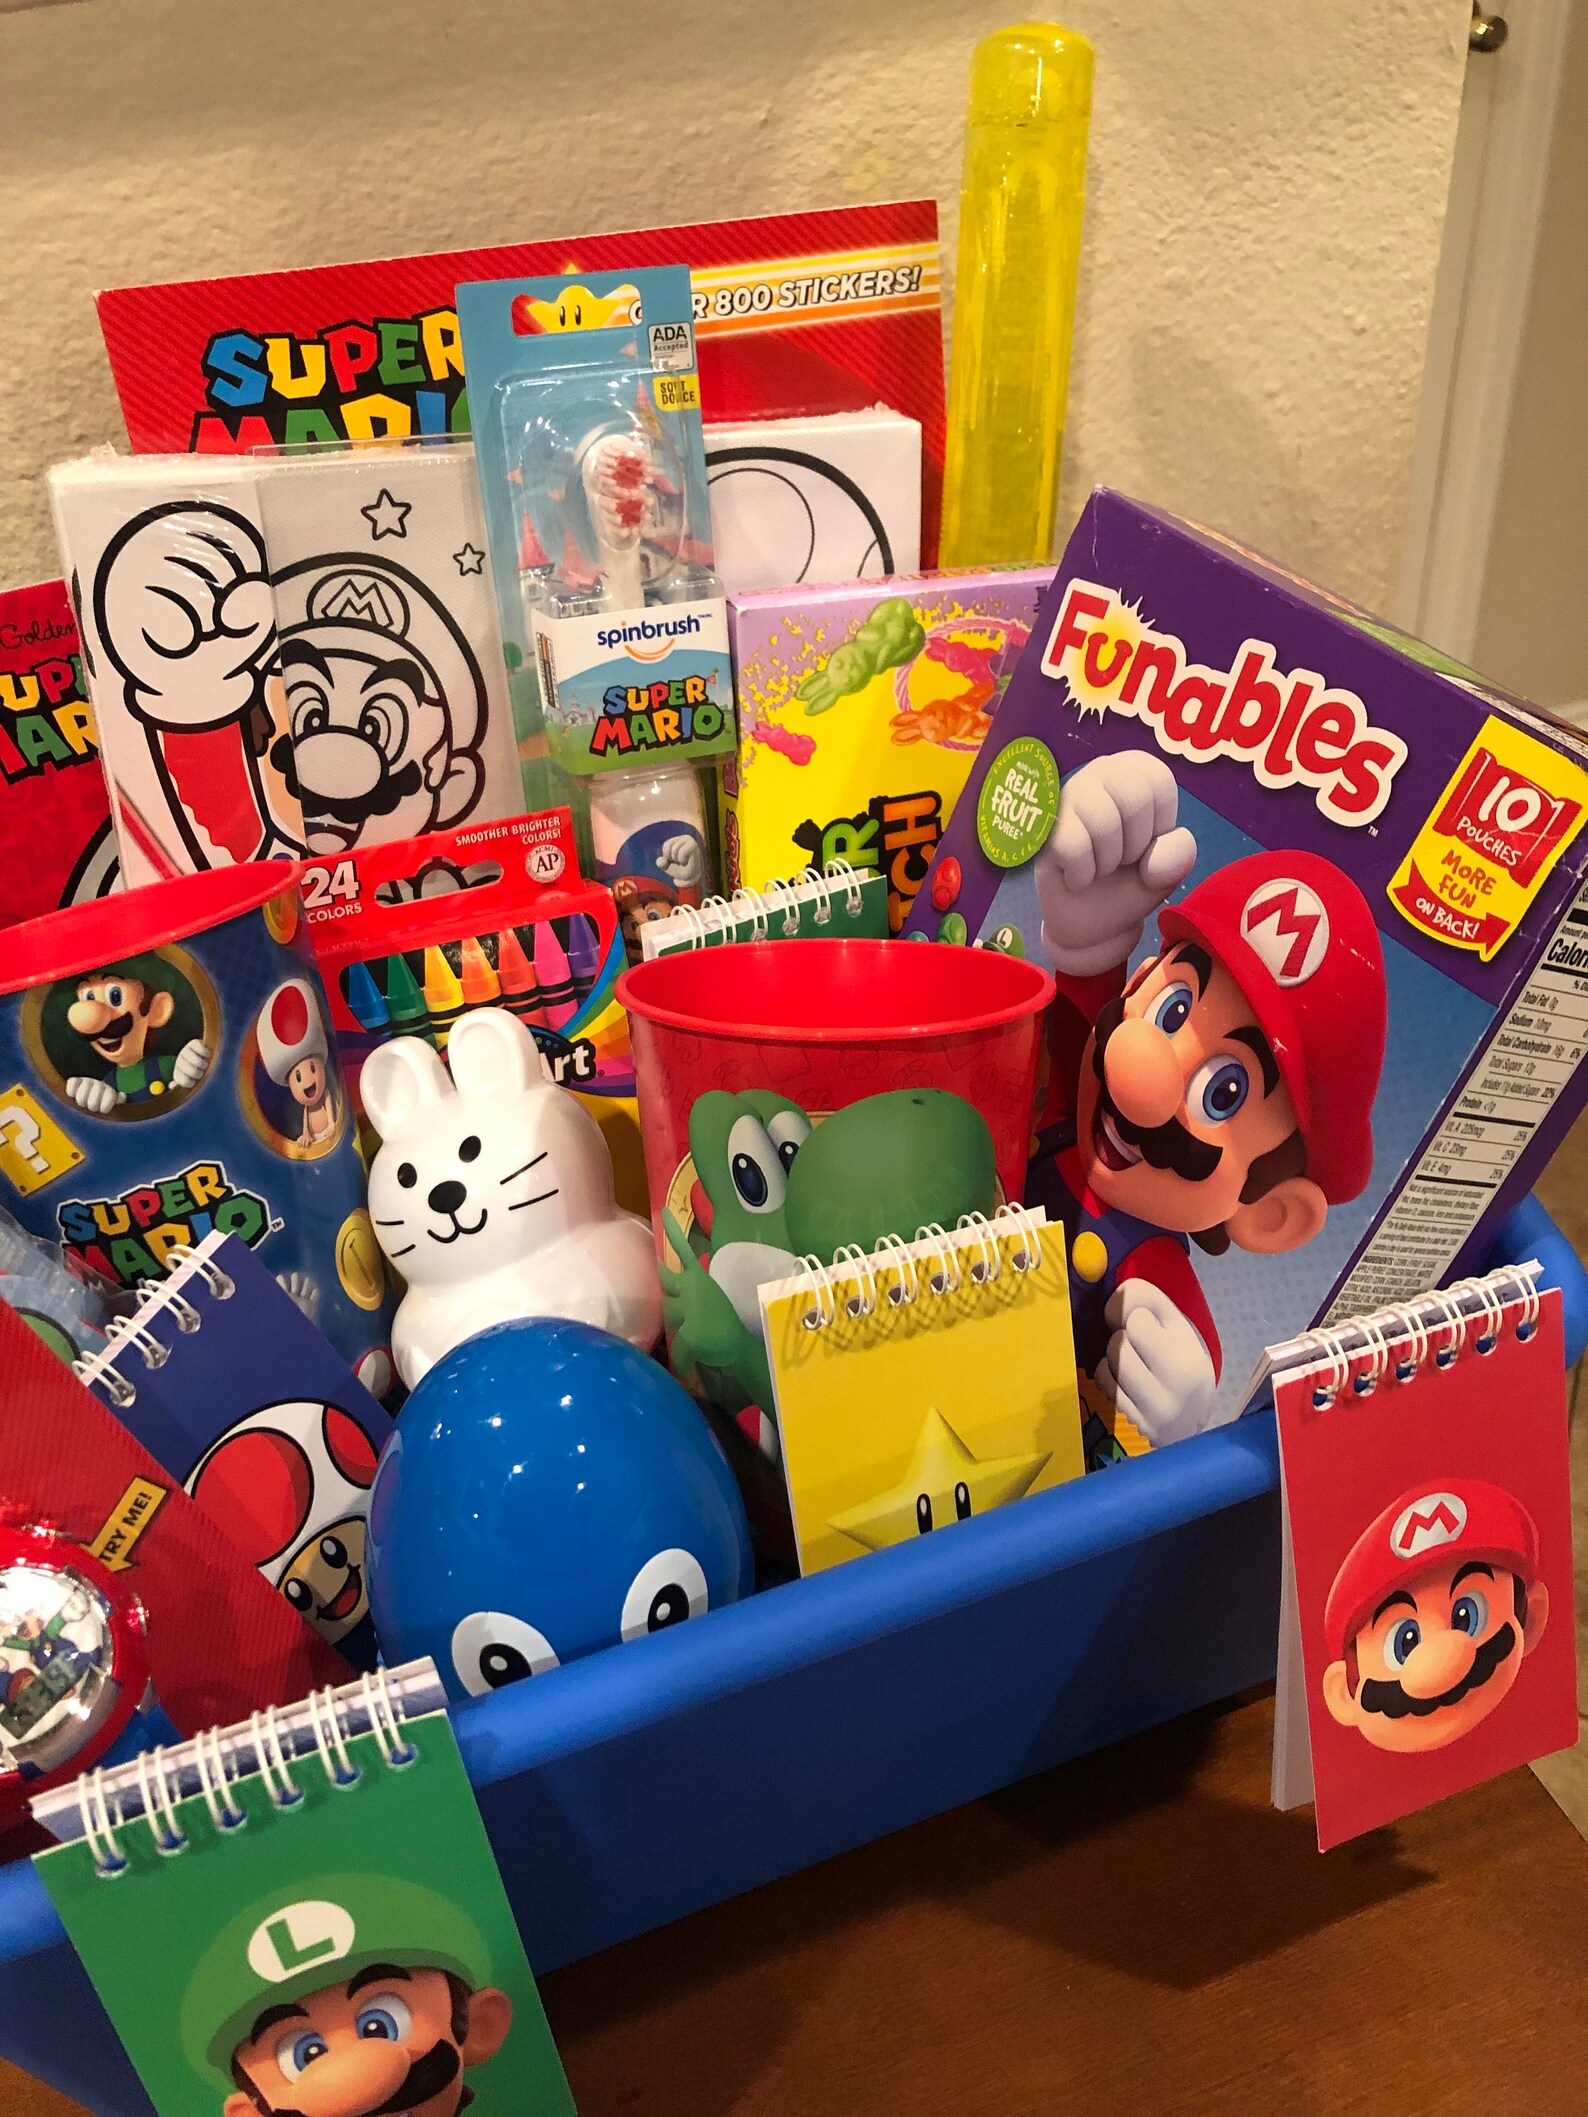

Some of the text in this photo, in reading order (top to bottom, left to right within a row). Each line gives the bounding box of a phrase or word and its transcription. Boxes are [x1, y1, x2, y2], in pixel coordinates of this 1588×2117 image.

[714, 284, 772, 316] 800
[778, 265, 921, 308] STICKERS!
[653, 326, 687, 342] ADA
[653, 341, 689, 353] Accepted
[204, 308, 466, 408] SUPER
[662, 391, 695, 405] DOCE
[193, 392, 468, 456] MARI
[597, 614, 700, 649] spinbrush
[603, 675, 708, 716] SUPER
[1046, 586, 1398, 815] Funables
[589, 703, 724, 757] MARIO
[1005, 768, 1039, 804] REAL
[1034, 748, 1055, 787] SOURCE
[991, 785, 1043, 833] FRUIT
[1478, 776, 1542, 832] 10
[455, 816, 561, 847] SMOOTHER BRIGHTER
[522, 829, 562, 846] COLORS!
[1457, 816, 1522, 866] POUCHES
[536, 853, 559, 873] AP
[1441, 849, 1497, 896] MORE
[300, 860, 360, 909] 24
[1439, 874, 1477, 909] FUN
[306, 903, 362, 925] COLORS
[1415, 897, 1480, 940] ON BACK!
[1511, 1035, 1551, 1054] Carbohydrate
[61, 1163, 227, 1242] SUPER
[100, 1492, 152, 1563] TRY ME!
